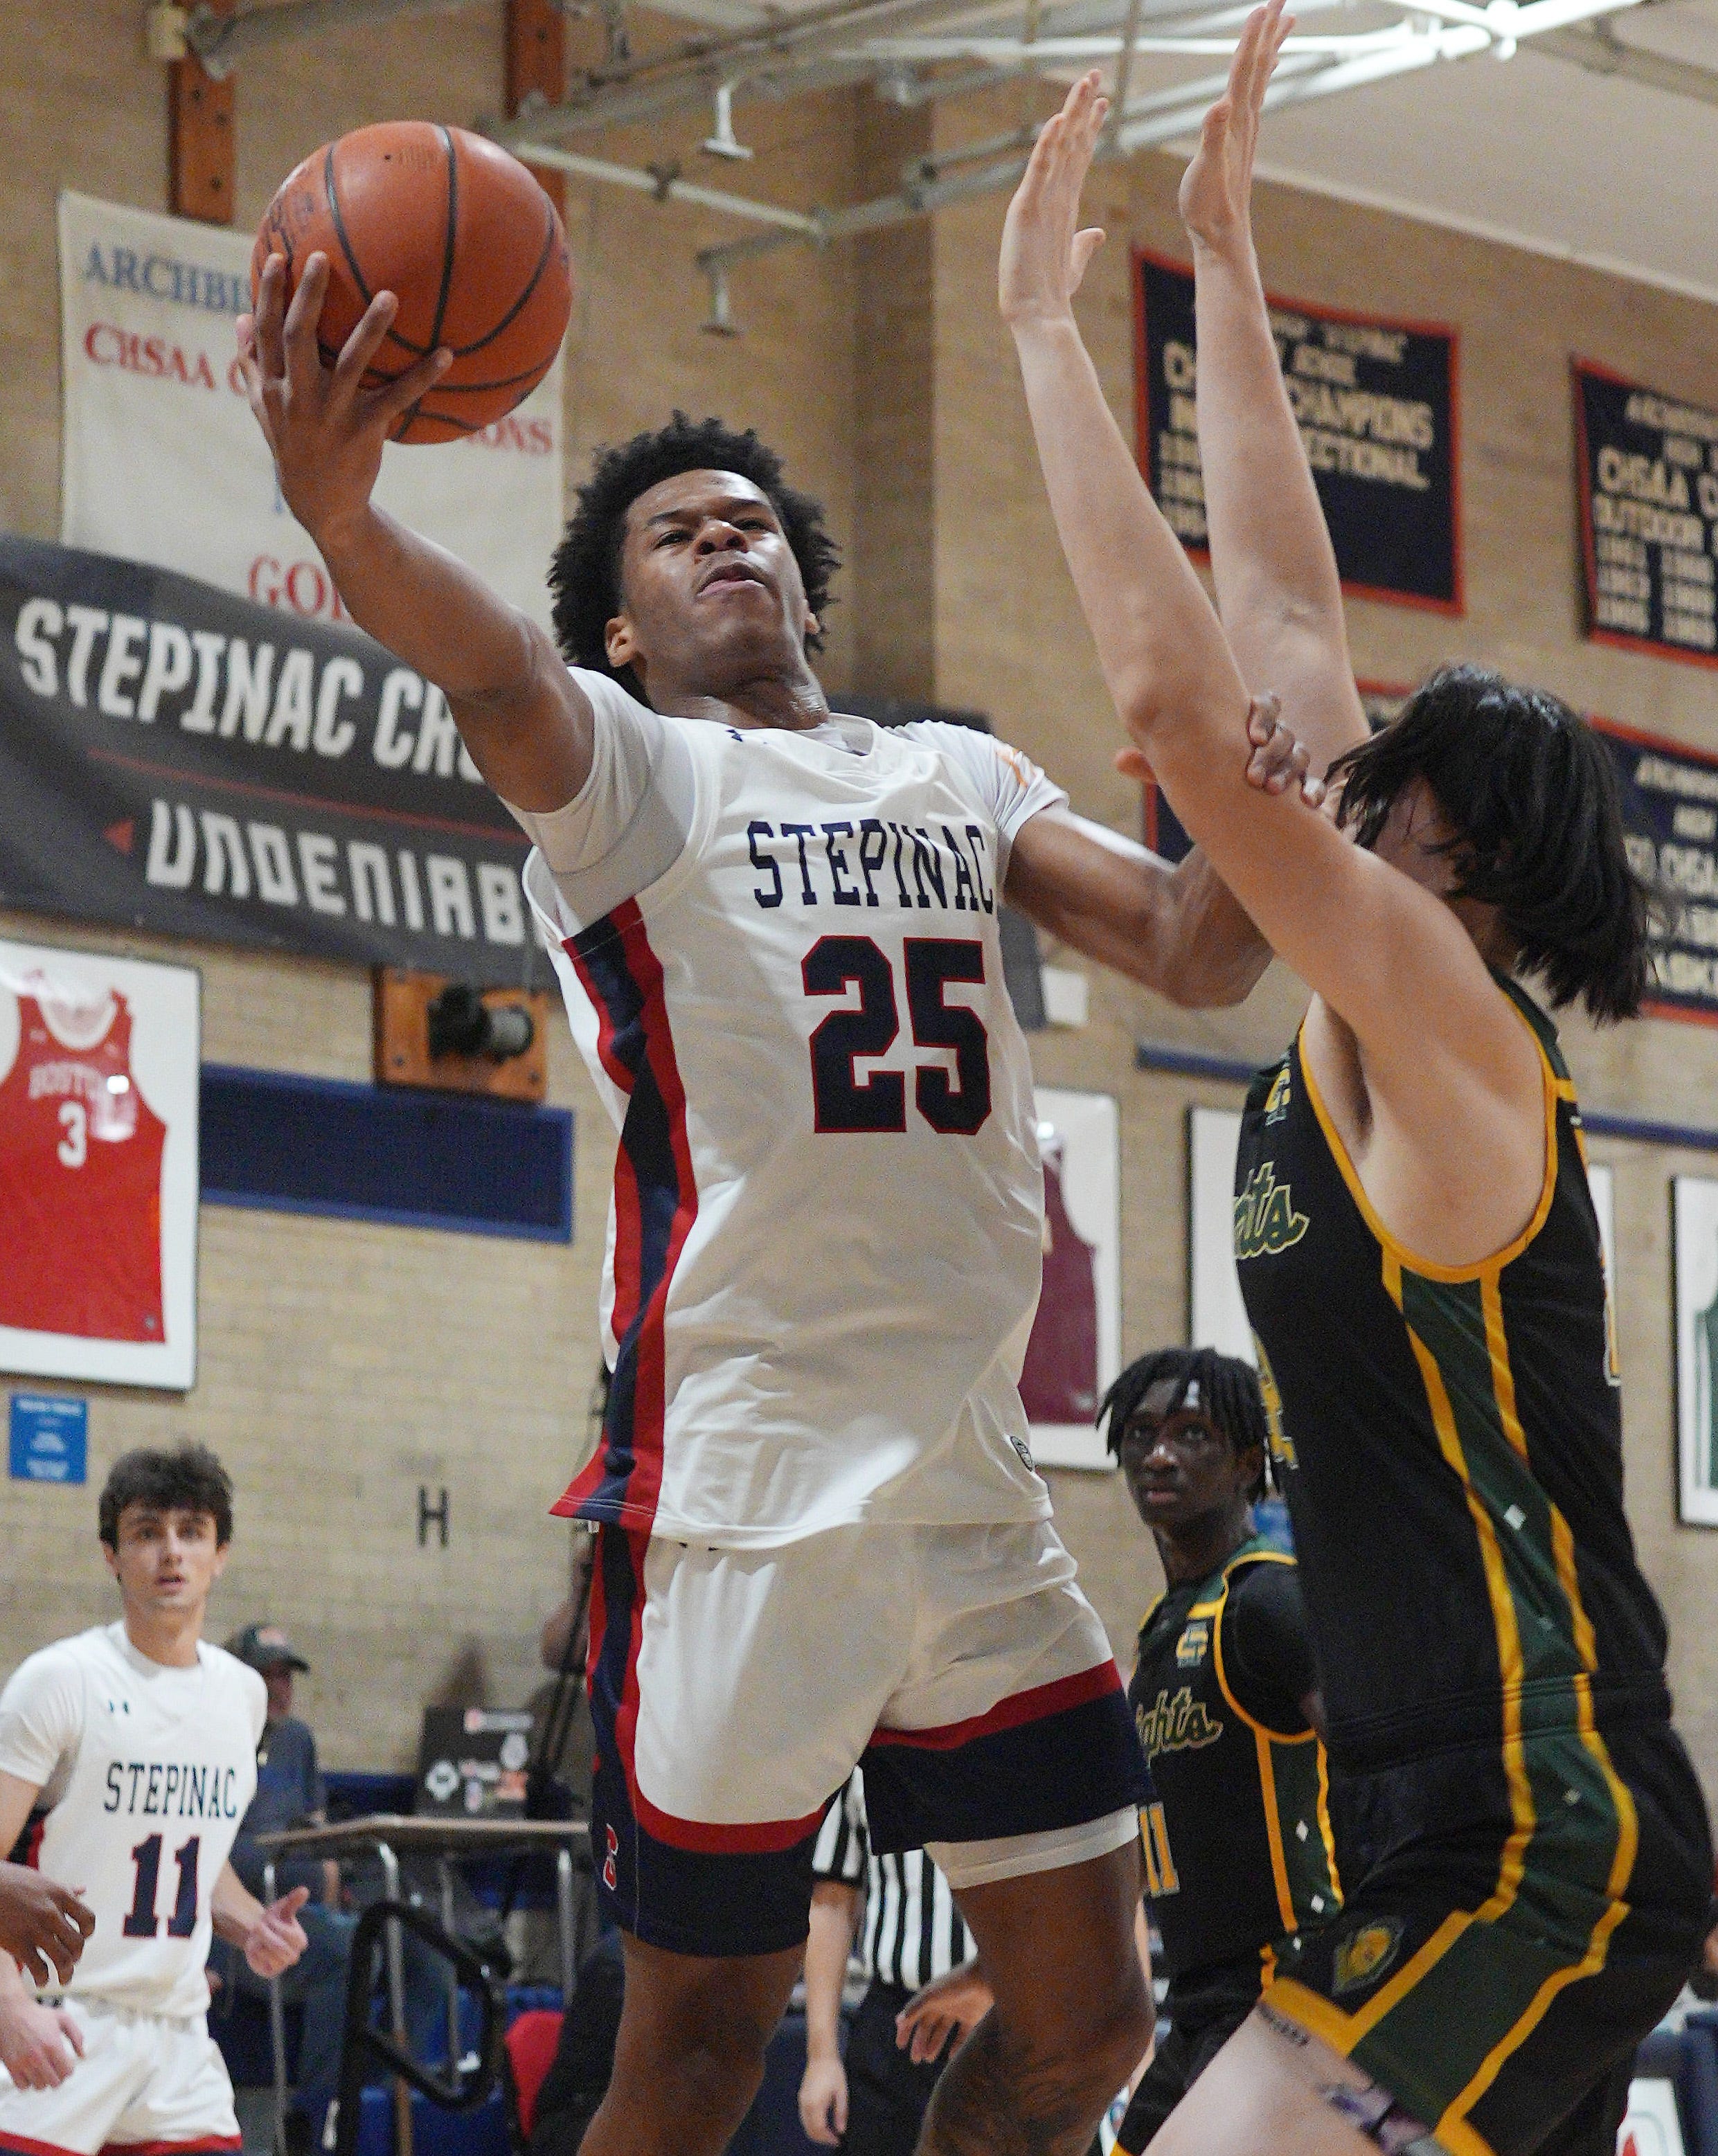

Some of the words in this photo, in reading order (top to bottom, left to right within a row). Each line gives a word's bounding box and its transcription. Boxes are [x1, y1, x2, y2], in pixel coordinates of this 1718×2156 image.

[84, 241, 251, 316] ARCHBI
[83, 321, 216, 391] CHSAA
[468, 417, 553, 456] ONS
[15, 595, 365, 759] STEPINAC
[145, 798, 544, 948] UNDENIAB
[746, 818, 994, 915] STEPINAC
[800, 935, 992, 1135] 25
[57, 1100, 87, 1169] 3
[103, 1761, 238, 1819] STEPINAC
[122, 1832, 202, 1939] 11
